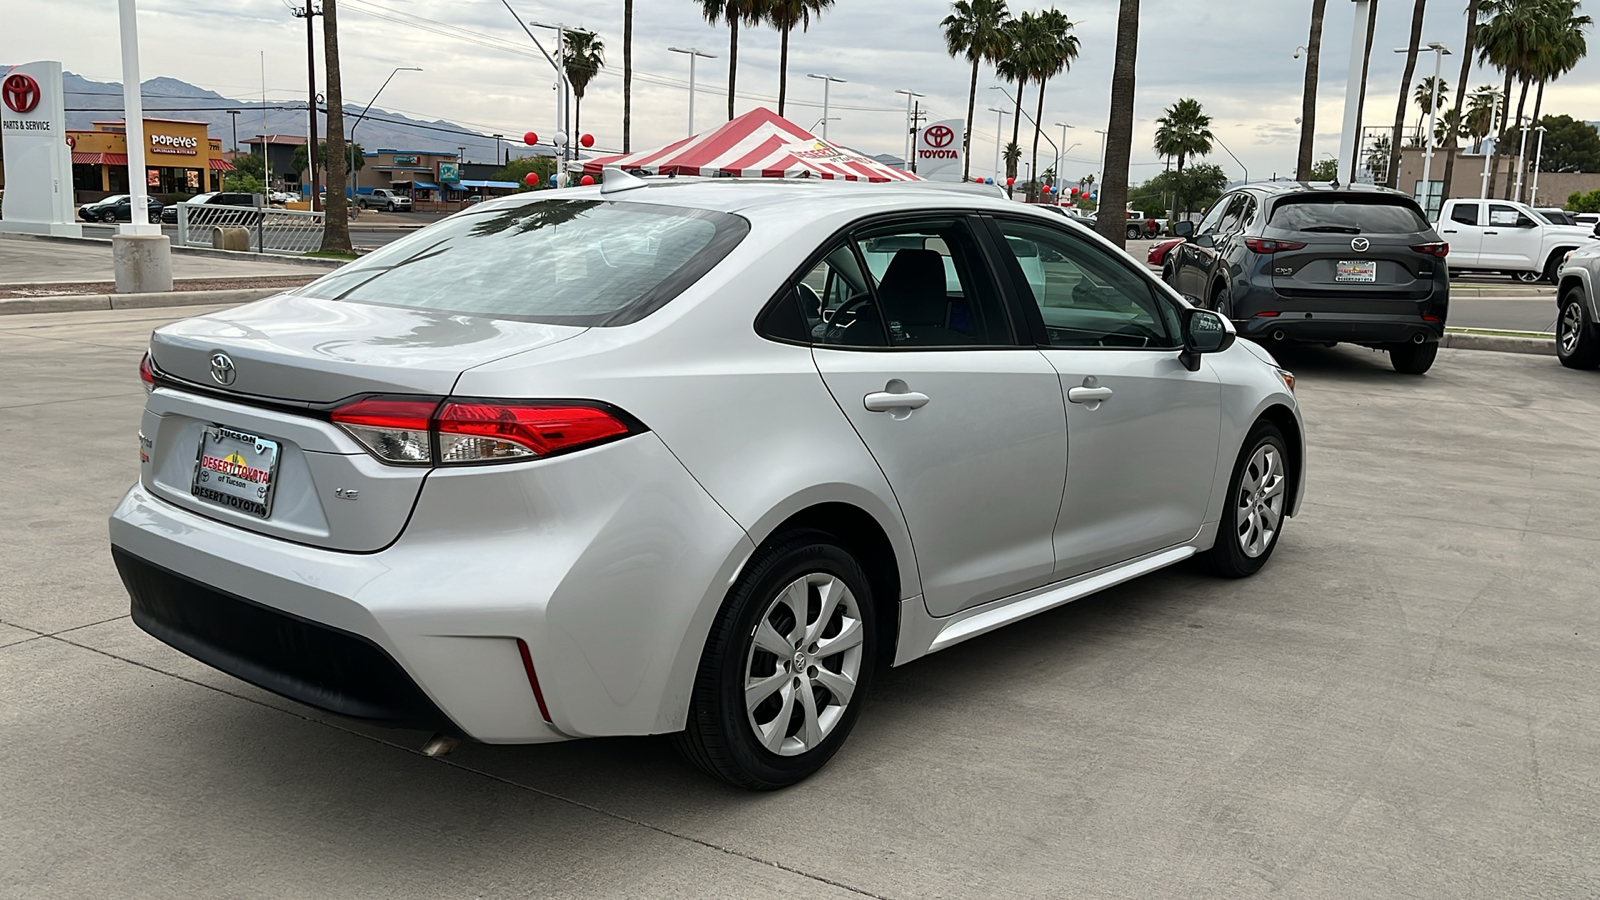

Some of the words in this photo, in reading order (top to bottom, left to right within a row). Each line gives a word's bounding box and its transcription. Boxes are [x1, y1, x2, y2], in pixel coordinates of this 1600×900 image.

[3, 121, 19, 130] PARTS
[20, 121, 24, 130] &
[25, 121, 50, 131] SERVICE
[918, 149, 958, 159] TOYOTA
[220, 429, 256, 444] TUCSON
[202, 455, 235, 474] DESERT
[236, 464, 269, 485] TOYOTA
[218, 475, 226, 483] of
[226, 477, 246, 489] Tucson
[194, 485, 225, 502] DESERT
[226, 495, 262, 515] TOYOTA
